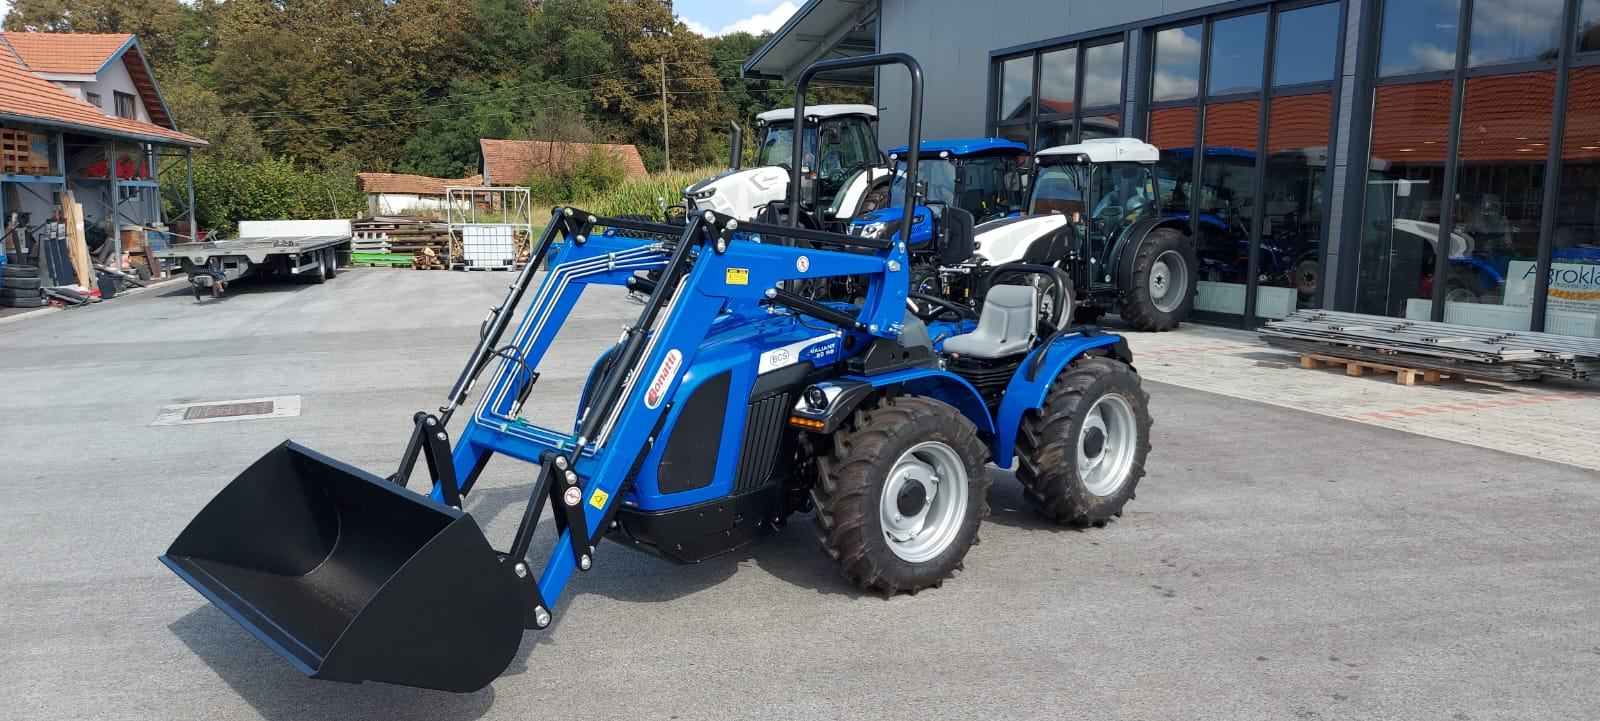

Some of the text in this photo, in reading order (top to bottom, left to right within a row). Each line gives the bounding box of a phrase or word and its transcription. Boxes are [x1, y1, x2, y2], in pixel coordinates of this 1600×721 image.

[810, 343, 835, 354] VALIANT
[771, 351, 788, 364] BCS
[648, 351, 677, 407] Bonatti
